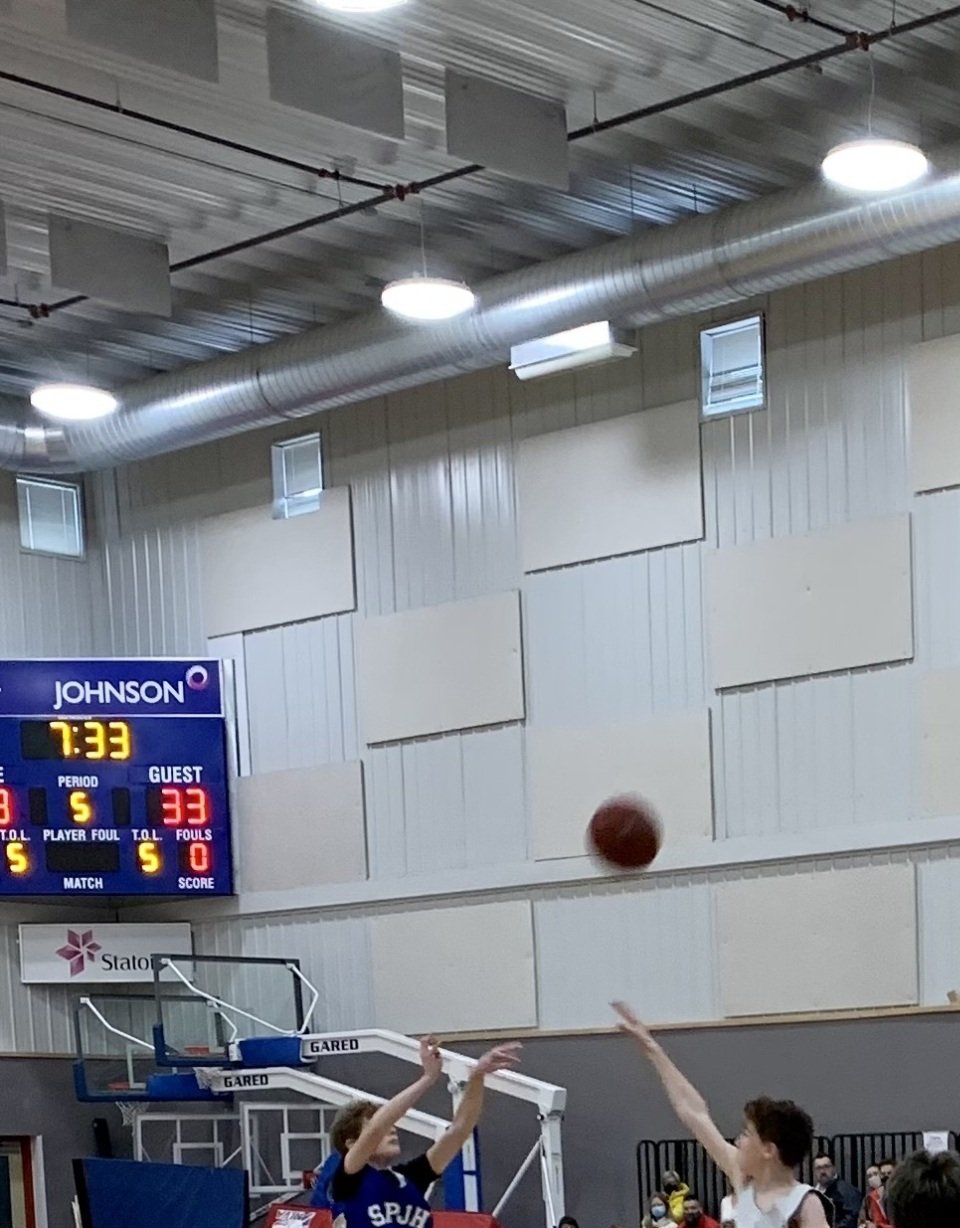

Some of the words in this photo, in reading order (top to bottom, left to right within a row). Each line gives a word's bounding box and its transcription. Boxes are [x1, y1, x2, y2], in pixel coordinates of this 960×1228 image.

[53, 680, 185, 710] JOHNSON
[49, 720, 131, 760] 7:33
[58, 775, 99, 788] PERIOD
[149, 765, 203, 784] GUEST
[161, 788, 208, 825] 33
[43, 829, 86, 841] PLAYER
[91, 829, 120, 841] FOUL
[131, 829, 163, 841] T.O.L.
[176, 829, 213, 841] FOULS
[189, 842, 209, 872] 0
[63, 877, 104, 890] MATCH
[178, 877, 215, 890] SCORE
[310, 1038, 360, 1053] GARED
[224, 1073, 269, 1088] GARED
